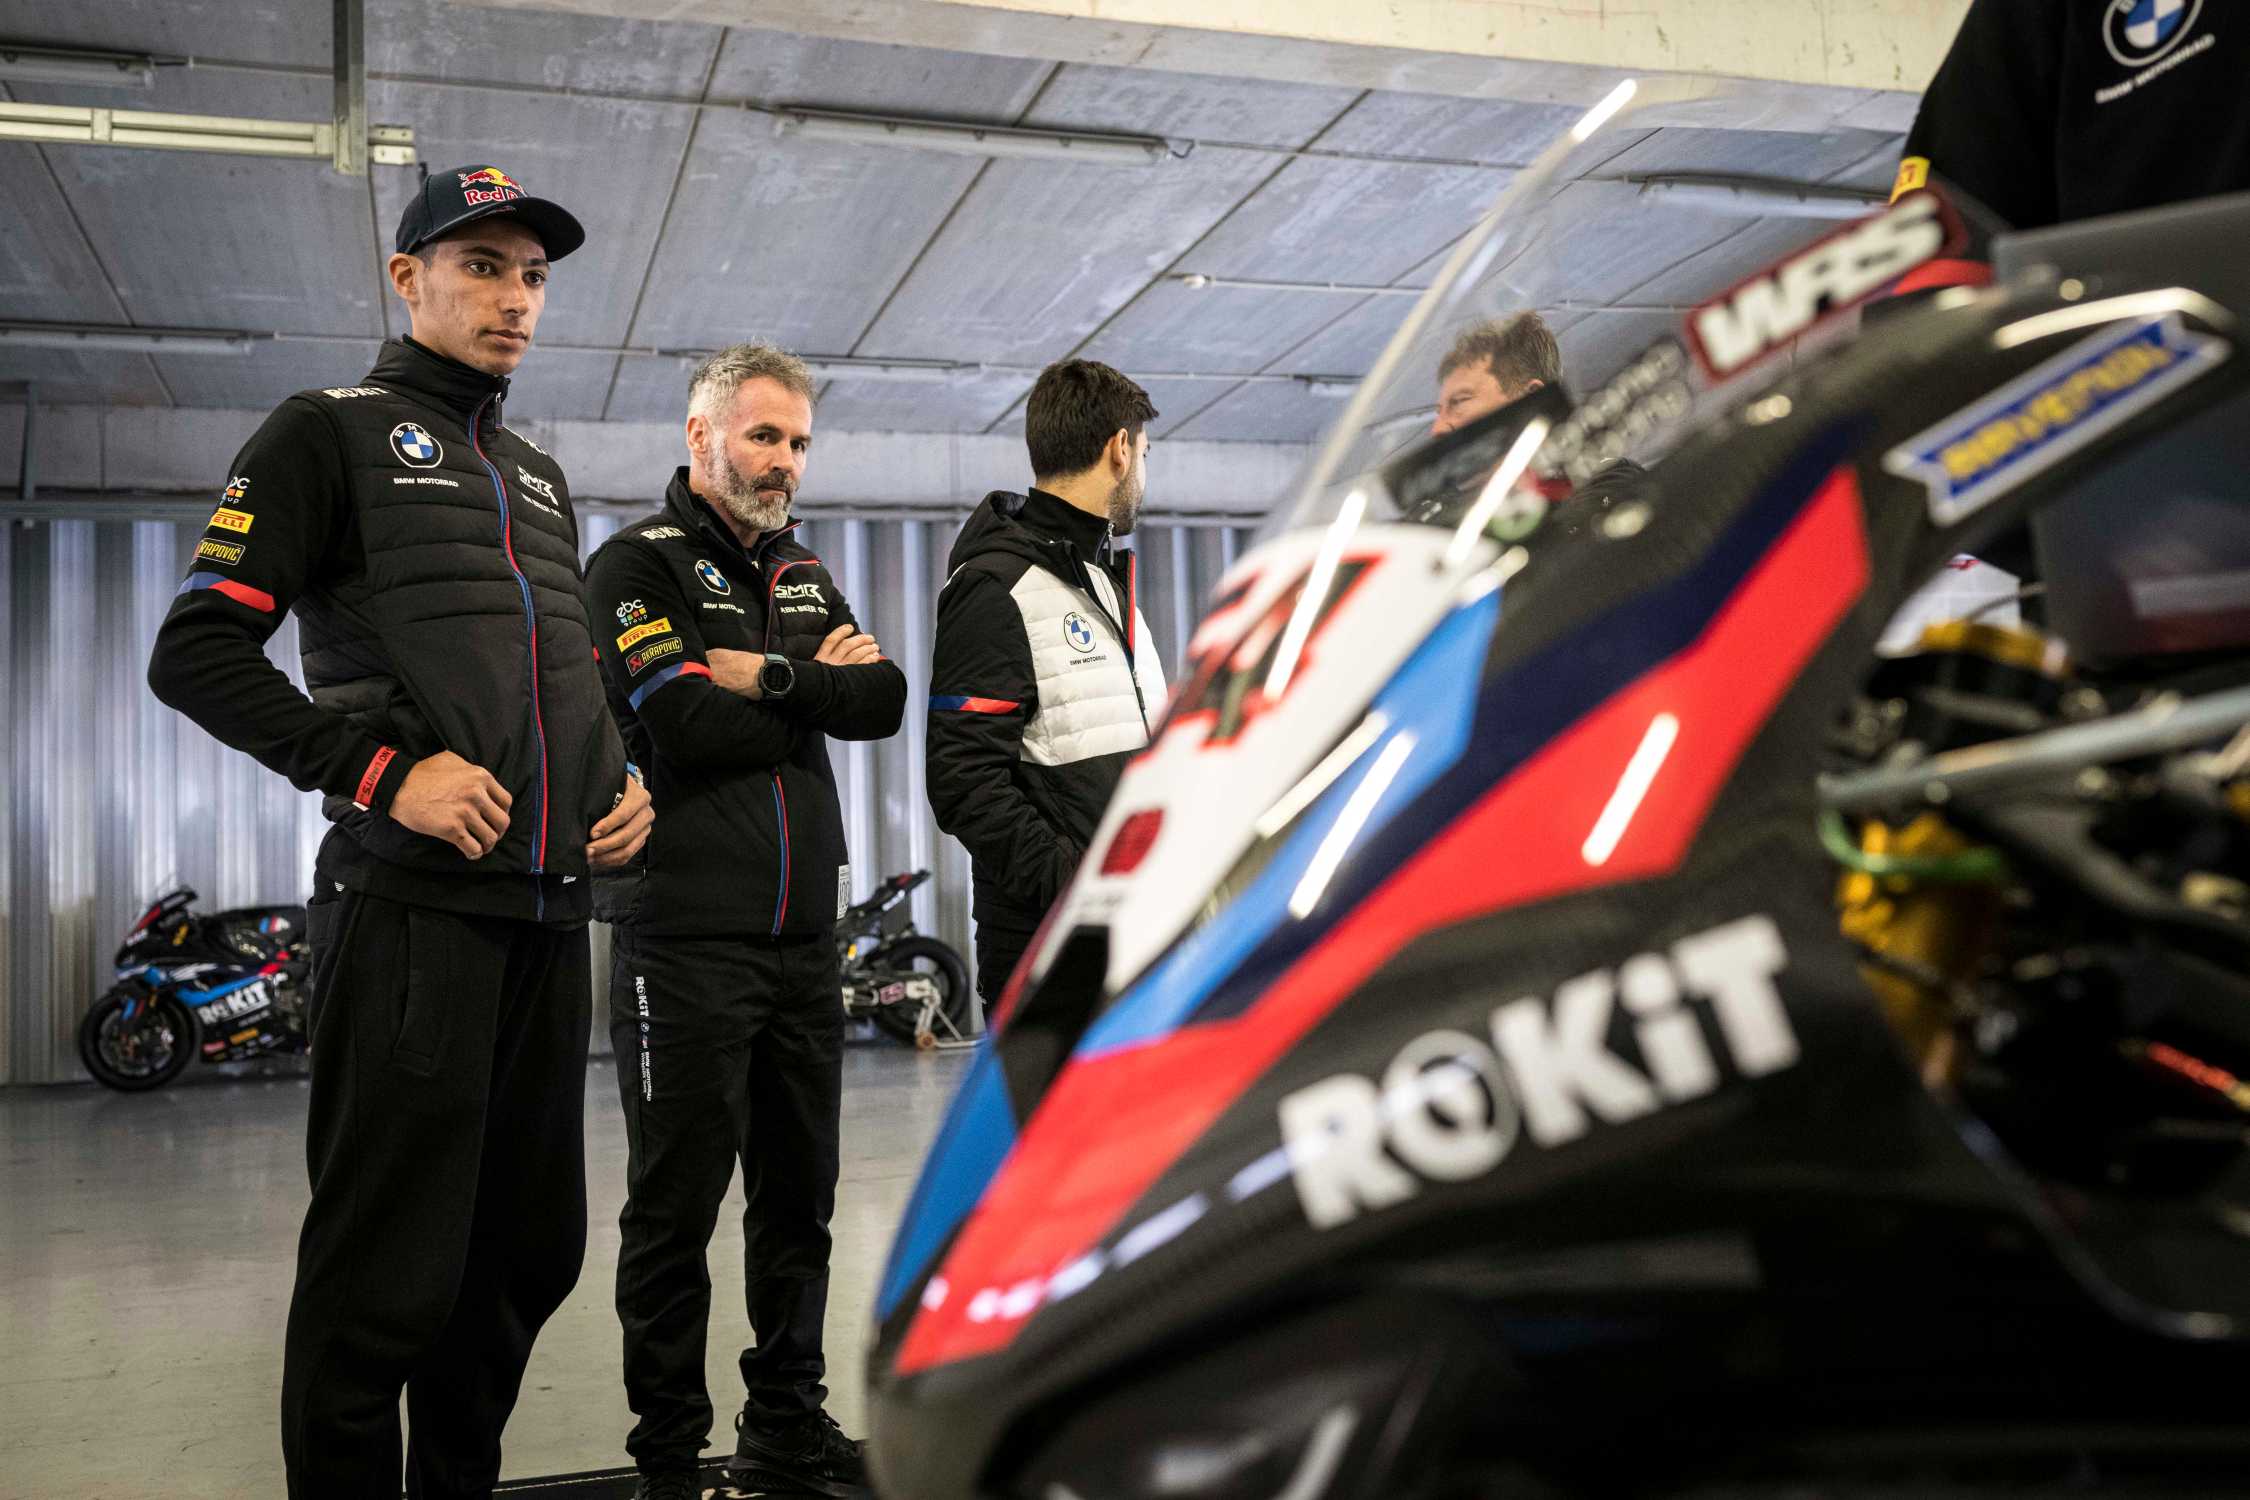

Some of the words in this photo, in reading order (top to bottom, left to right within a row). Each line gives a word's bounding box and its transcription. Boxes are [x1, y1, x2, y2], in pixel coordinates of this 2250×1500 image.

[464, 186, 506, 207] Red
[393, 477, 415, 485] BMW
[416, 477, 459, 488] MOTORRAD
[214, 512, 247, 529] ELLI
[775, 583, 826, 604] SMR
[616, 599, 644, 618] ebc
[1277, 913, 1800, 1231] ROKiT
